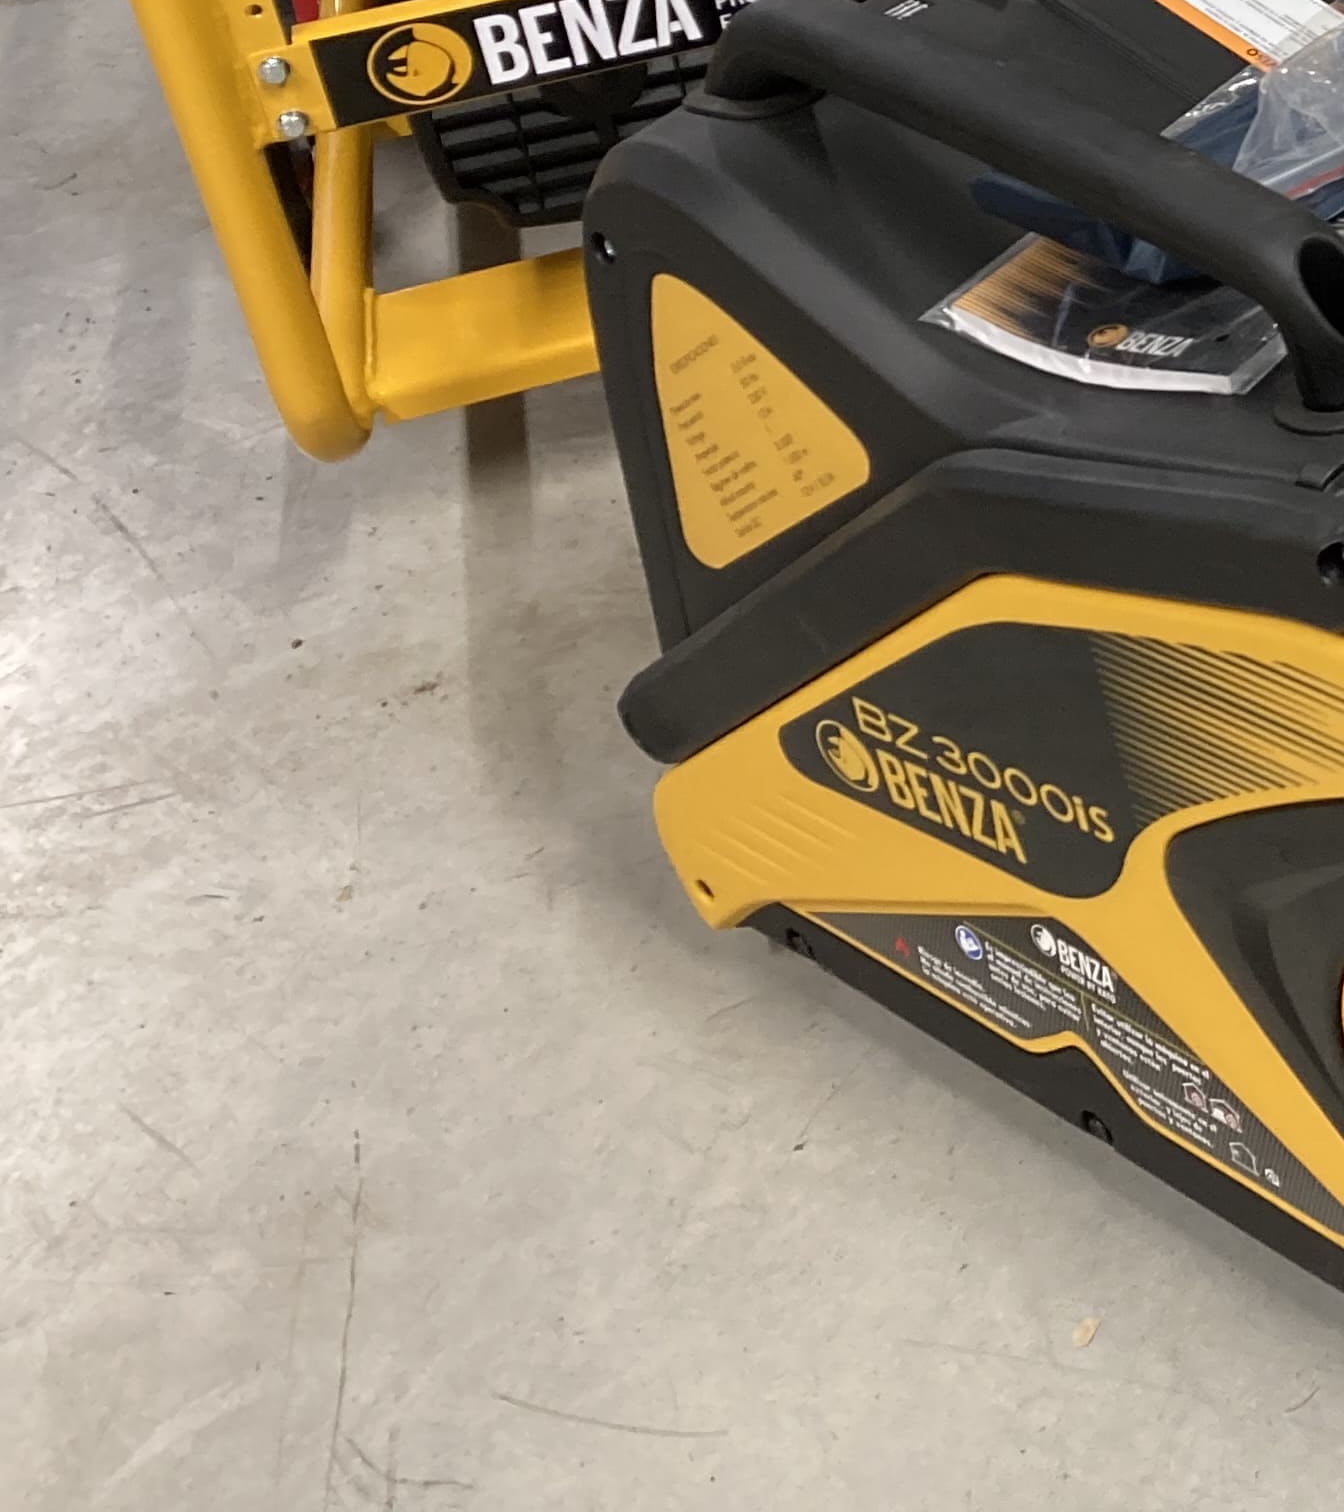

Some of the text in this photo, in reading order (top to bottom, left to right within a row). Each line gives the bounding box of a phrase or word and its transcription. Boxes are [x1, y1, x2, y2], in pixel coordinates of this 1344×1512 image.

[852, 696, 928, 760] BZ
[876, 748, 1028, 865] BENZA
[1056, 939, 1115, 993] BENZA
